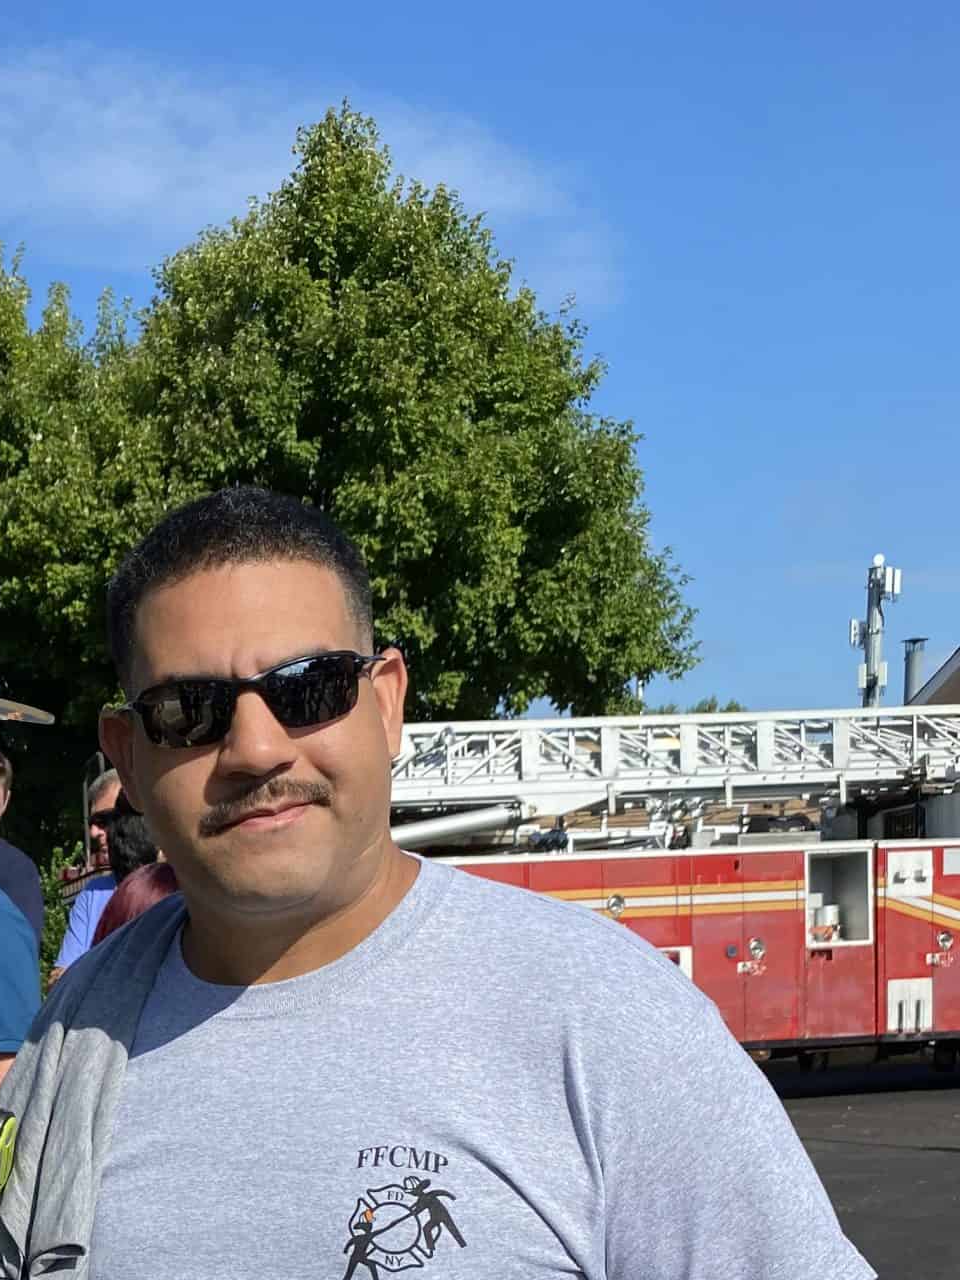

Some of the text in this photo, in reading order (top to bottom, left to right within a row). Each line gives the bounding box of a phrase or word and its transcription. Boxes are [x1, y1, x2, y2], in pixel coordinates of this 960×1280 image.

[357, 1145, 449, 1174] FFCMP
[387, 1190, 405, 1201] FD
[385, 1255, 404, 1267] NY
